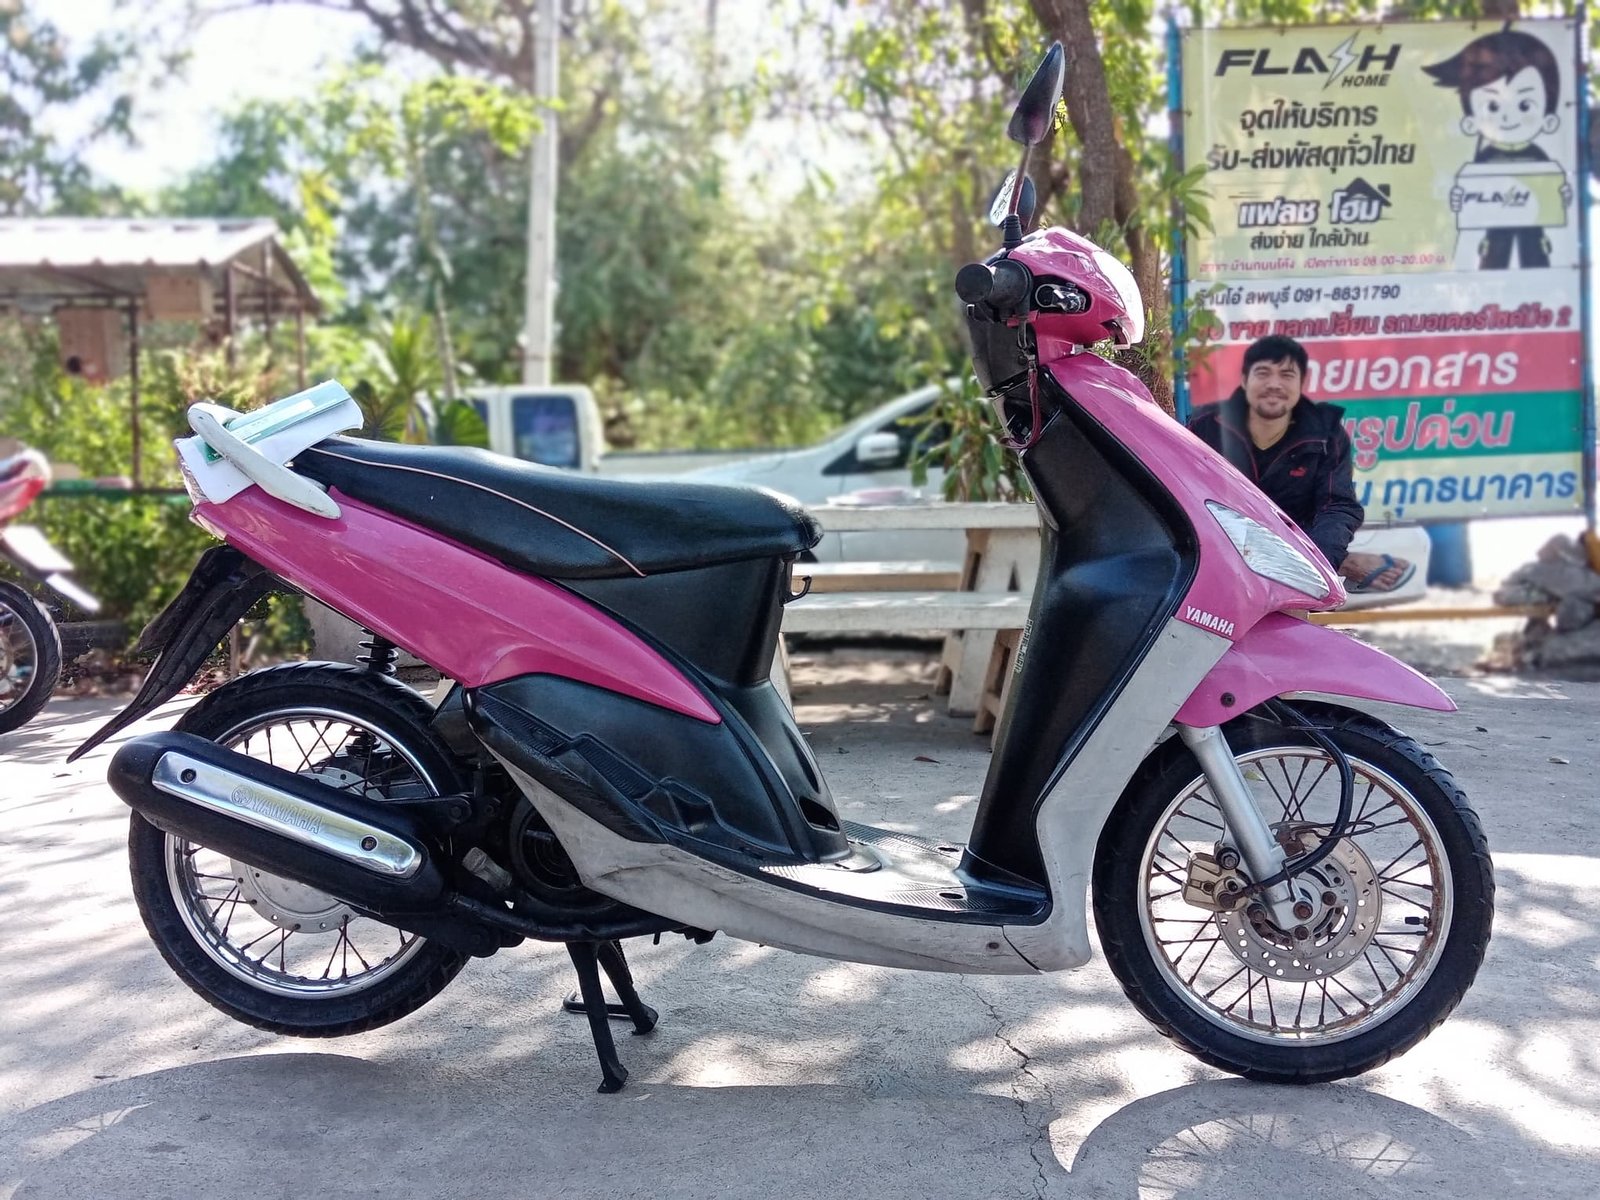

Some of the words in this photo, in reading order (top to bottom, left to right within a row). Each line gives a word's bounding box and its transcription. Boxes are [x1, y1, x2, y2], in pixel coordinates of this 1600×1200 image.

[1342, 73, 1392, 89] HOME
[1239, 99, 1379, 138] จุดให้บริการ
[1206, 133, 1416, 174] รับ-ส่งพัสดุทั่วไทย
[1238, 195, 1320, 228] แฟลช
[1250, 230, 1304, 250] ส่งง่าย
[1308, 227, 1370, 249] ใกล้บ้าน
[1293, 285, 1400, 304] 091-8831790
[1304, 351, 1519, 393] ายเอกสาร
[1382, 470, 1578, 517] ทุกธนาคาร
[1186, 606, 1235, 636] YAMAHA
[252, 793, 323, 835] YAMAHA
